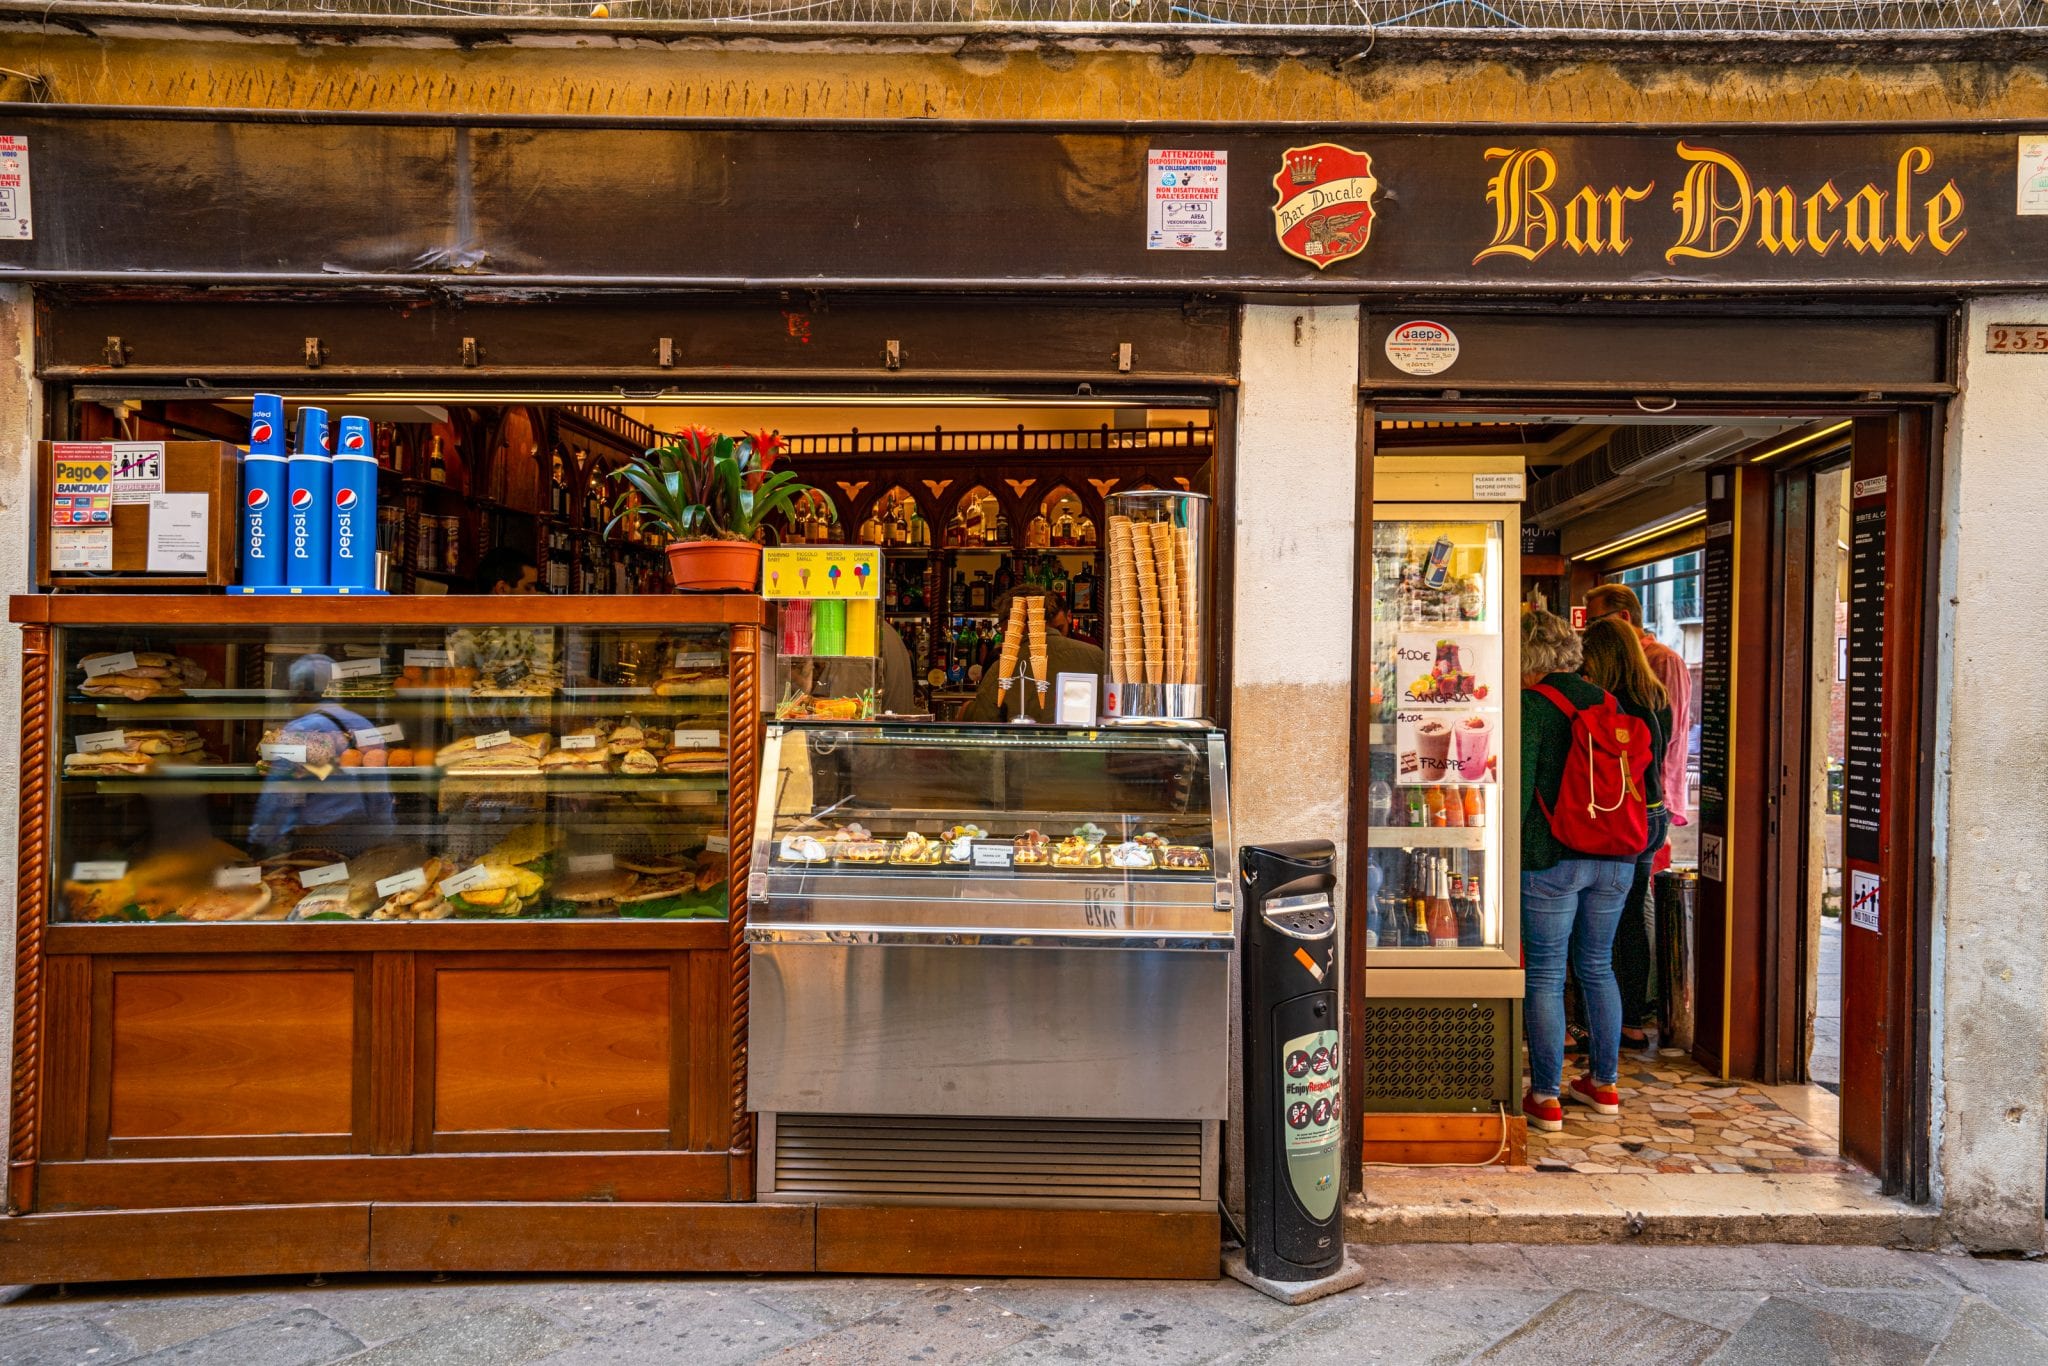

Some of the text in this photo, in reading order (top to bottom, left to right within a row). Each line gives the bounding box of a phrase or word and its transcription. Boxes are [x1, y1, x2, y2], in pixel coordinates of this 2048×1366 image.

[1161, 150, 1215, 158] ATTENZIONE
[1280, 178, 1363, 233] Bar Ducale
[1471, 139, 1968, 266] Bar Ducale
[57, 463, 92, 481] Pago
[58, 484, 108, 493] BANCOMAT
[249, 512, 266, 558] pepsi
[293, 512, 309, 558] pepsi
[338, 512, 354, 558] pepsi
[1404, 691, 1471, 704] SANGRIA
